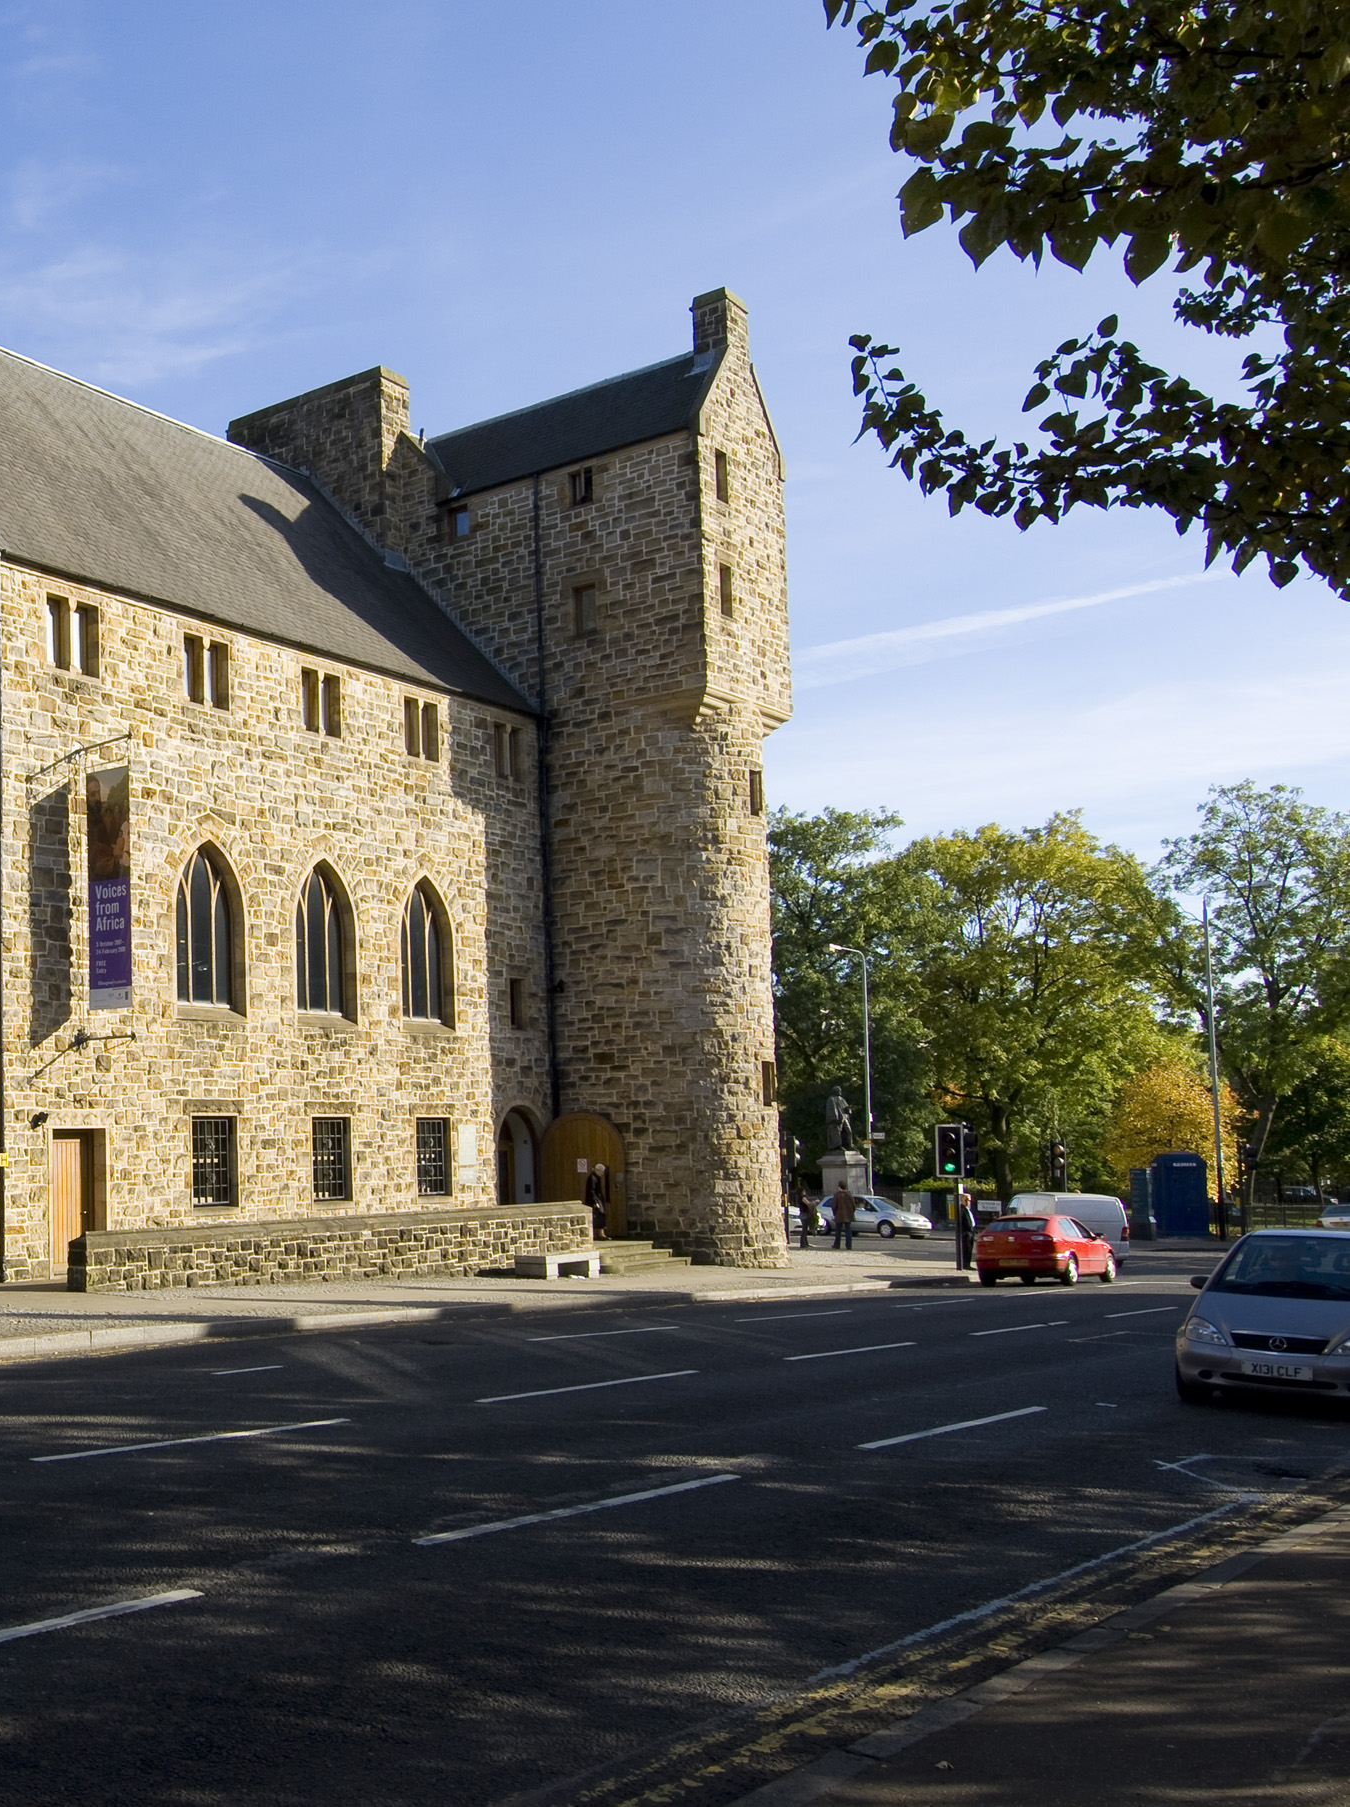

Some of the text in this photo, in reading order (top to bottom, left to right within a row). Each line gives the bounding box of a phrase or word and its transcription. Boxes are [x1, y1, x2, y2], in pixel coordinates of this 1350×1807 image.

[95, 884, 127, 900] Voices
[95, 901, 120, 916] from
[96, 916, 125, 931] Africa
[1251, 1362, 1302, 1378] X131 CLF
